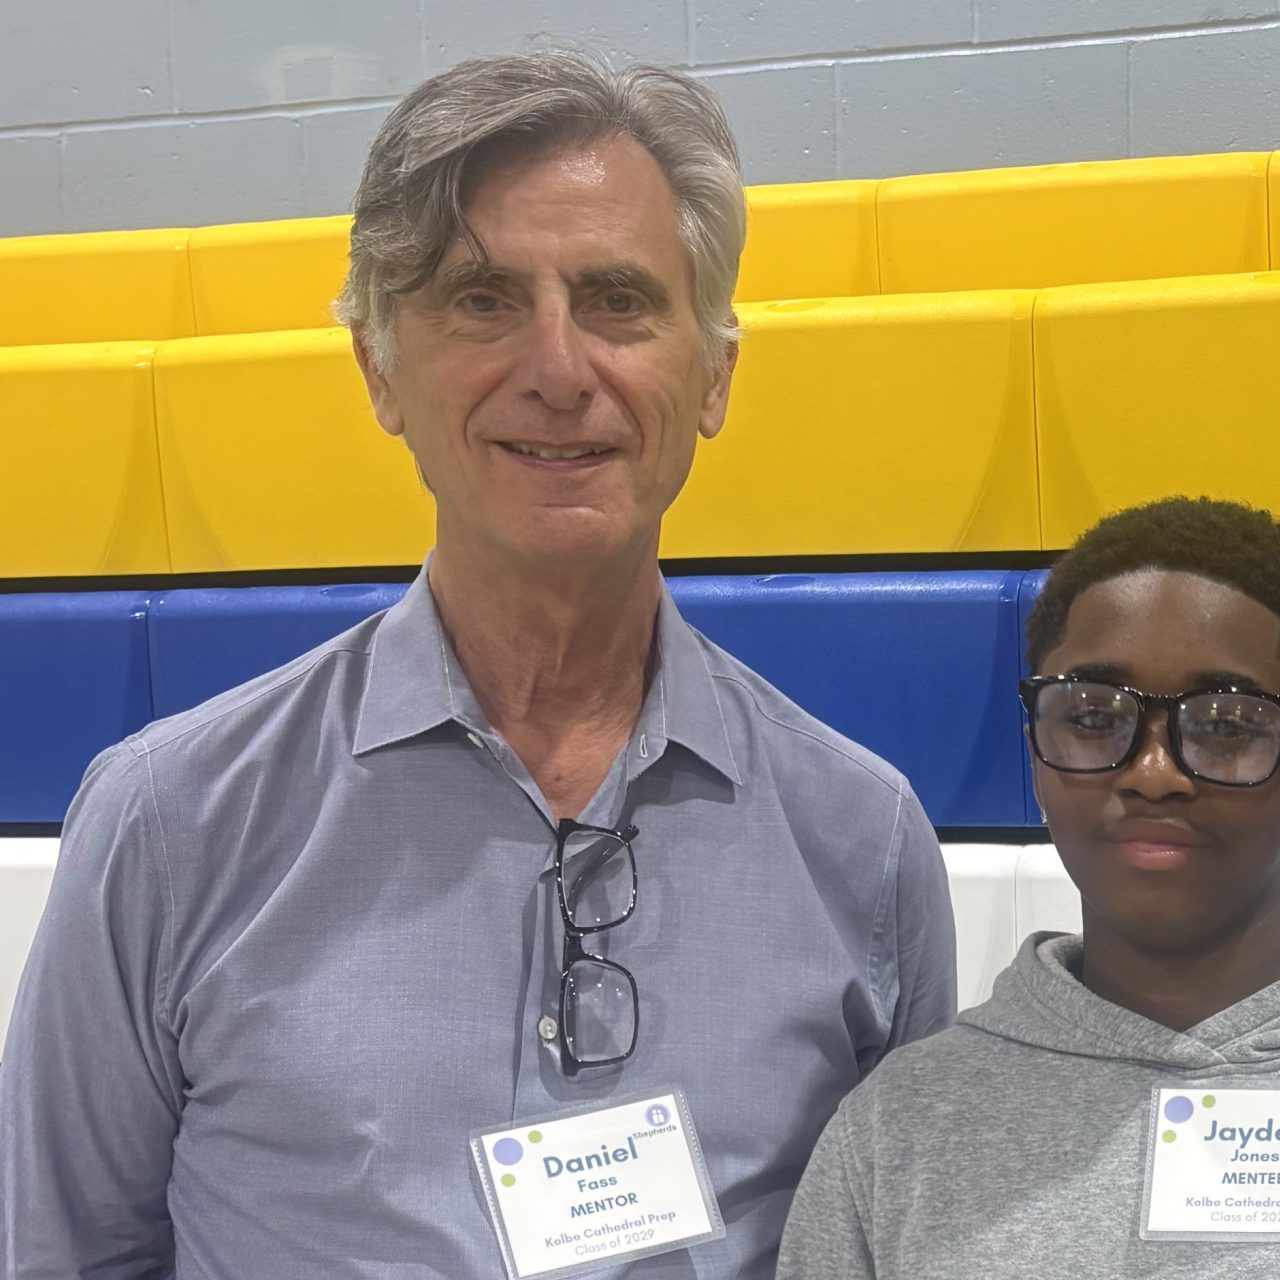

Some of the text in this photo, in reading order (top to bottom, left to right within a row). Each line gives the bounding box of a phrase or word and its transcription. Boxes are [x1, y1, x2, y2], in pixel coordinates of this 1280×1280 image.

[542, 1136, 638, 1178] Daniel
[1230, 1149, 1280, 1162] Jones
[577, 1176, 618, 1192] Fass
[570, 1192, 639, 1218] MENTOR
[1186, 1197, 1221, 1208] Kolbe
[1210, 1211, 1242, 1222] Class
[1245, 1211, 1259, 1222] of
[544, 1210, 677, 1248] Kolbe Cathedral Prep
[575, 1229, 656, 1256] Class of 2029
